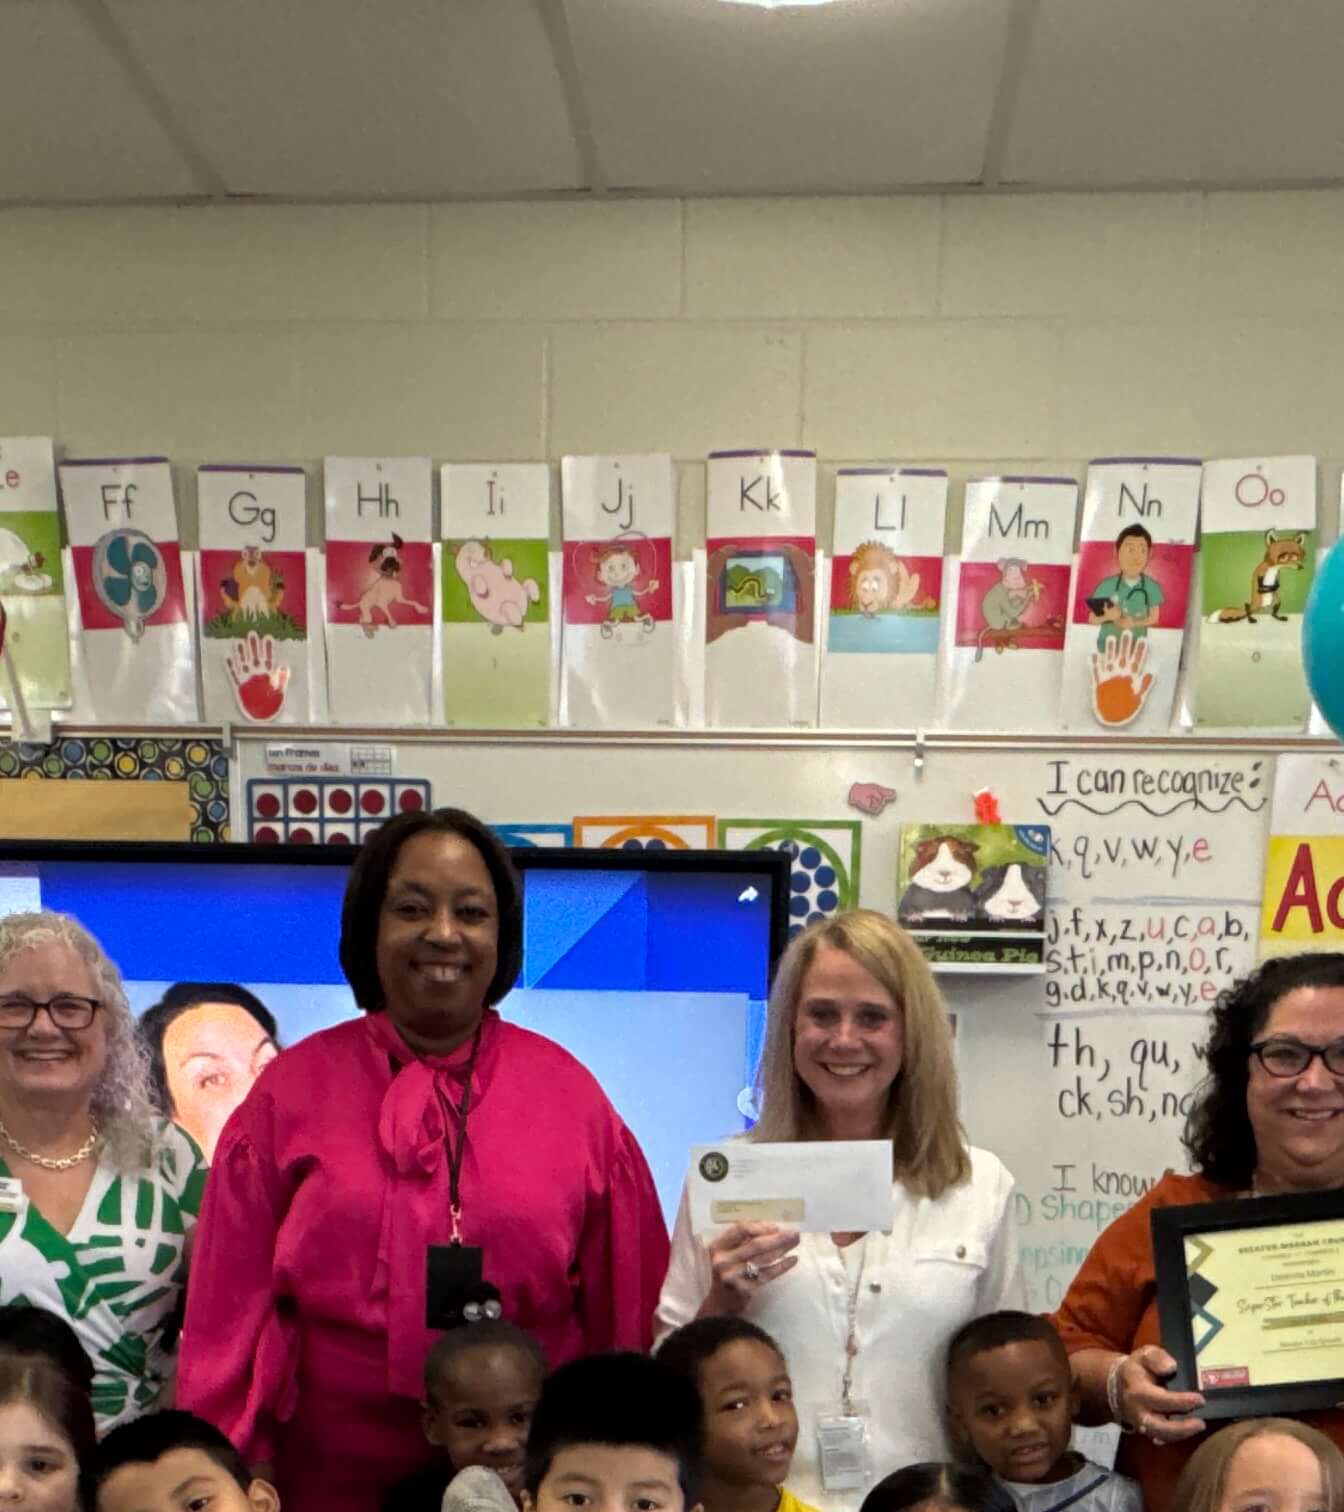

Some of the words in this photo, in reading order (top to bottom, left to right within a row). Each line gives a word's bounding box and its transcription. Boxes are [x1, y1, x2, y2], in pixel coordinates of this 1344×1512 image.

[100, 484, 140, 520] Ff
[357, 484, 400, 519] Hh
[485, 480, 505, 515] Ii
[601, 478, 634, 530] Jj
[739, 475, 781, 512] Kk
[1119, 482, 1163, 518] Nn
[1234, 473, 1286, 508] Oo
[228, 492, 276, 541] Gg
[874, 495, 907, 533] Ll
[988, 502, 1049, 539] Mm
[1047, 760, 1069, 795] I
[1076, 769, 1125, 796] can
[1052, 1164, 1077, 1192] I
